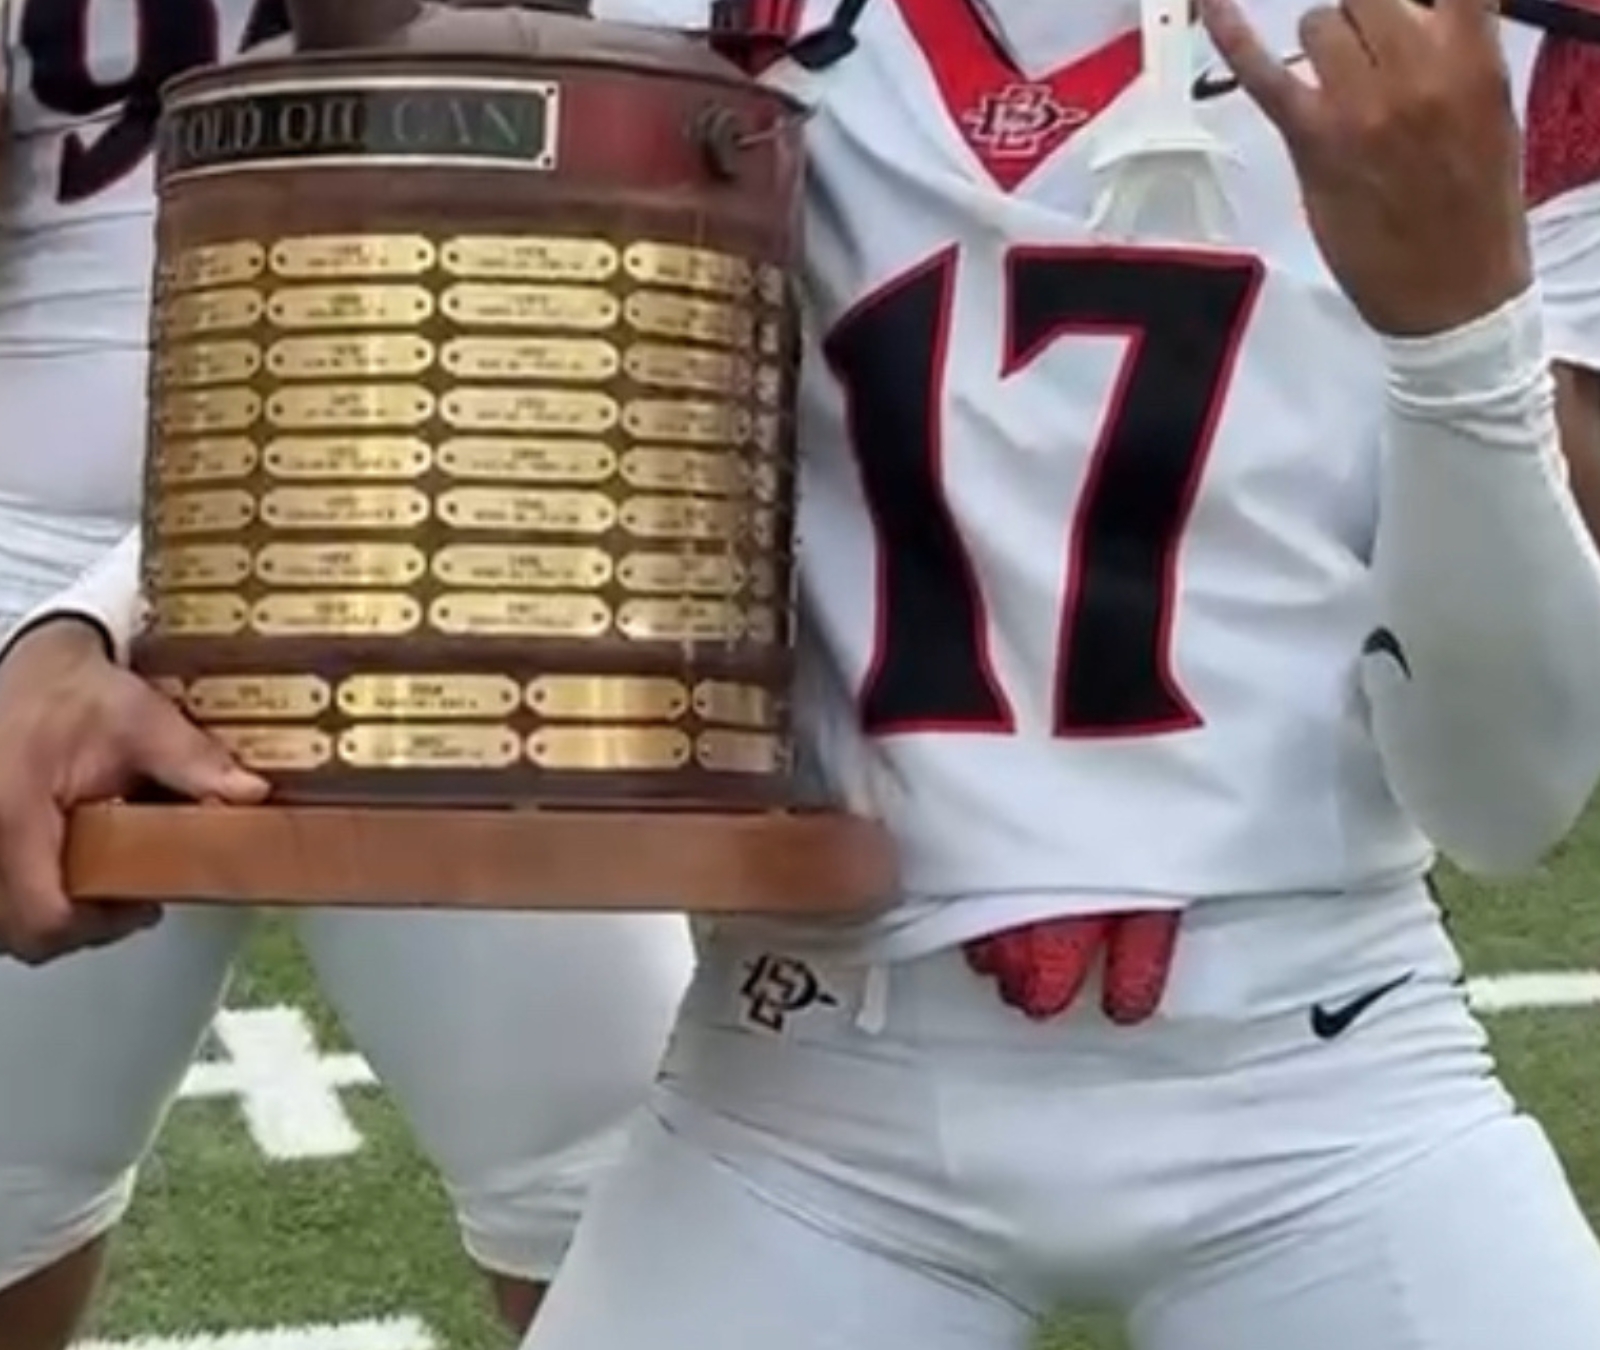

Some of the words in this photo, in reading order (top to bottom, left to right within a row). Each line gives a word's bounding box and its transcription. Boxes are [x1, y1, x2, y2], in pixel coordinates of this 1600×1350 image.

[187, 102, 264, 159] OLD
[390, 94, 525, 149] CAN
[821, 240, 1266, 739] 17
